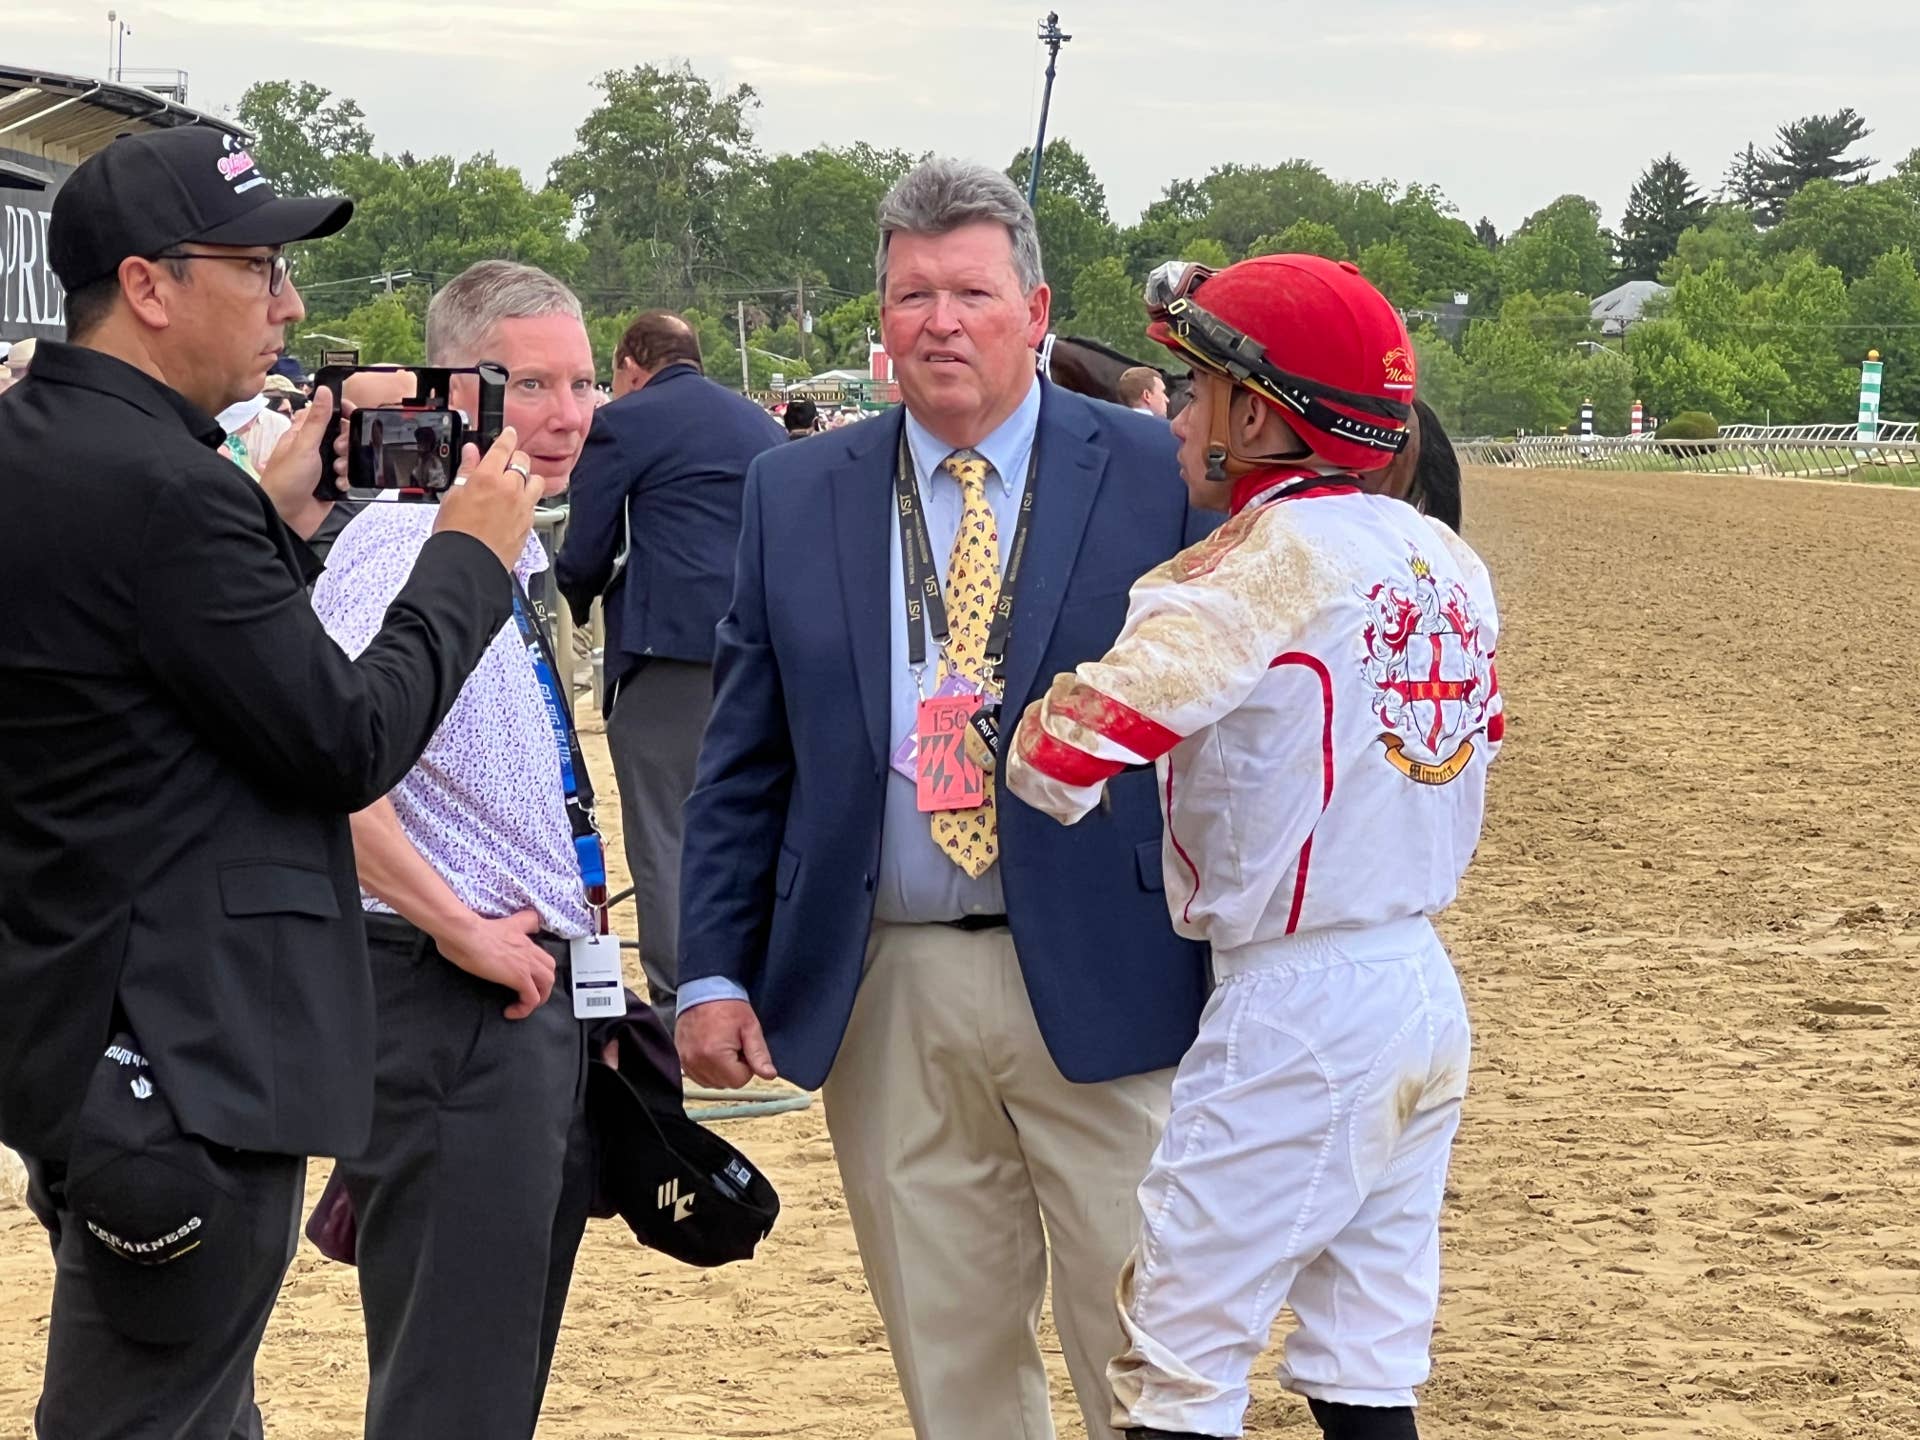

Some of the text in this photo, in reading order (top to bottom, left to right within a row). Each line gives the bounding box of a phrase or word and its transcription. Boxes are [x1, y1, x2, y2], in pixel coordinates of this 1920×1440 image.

[4, 205, 66, 326] PRE
[933, 709, 970, 733] 150
[977, 718, 994, 738] PAY
